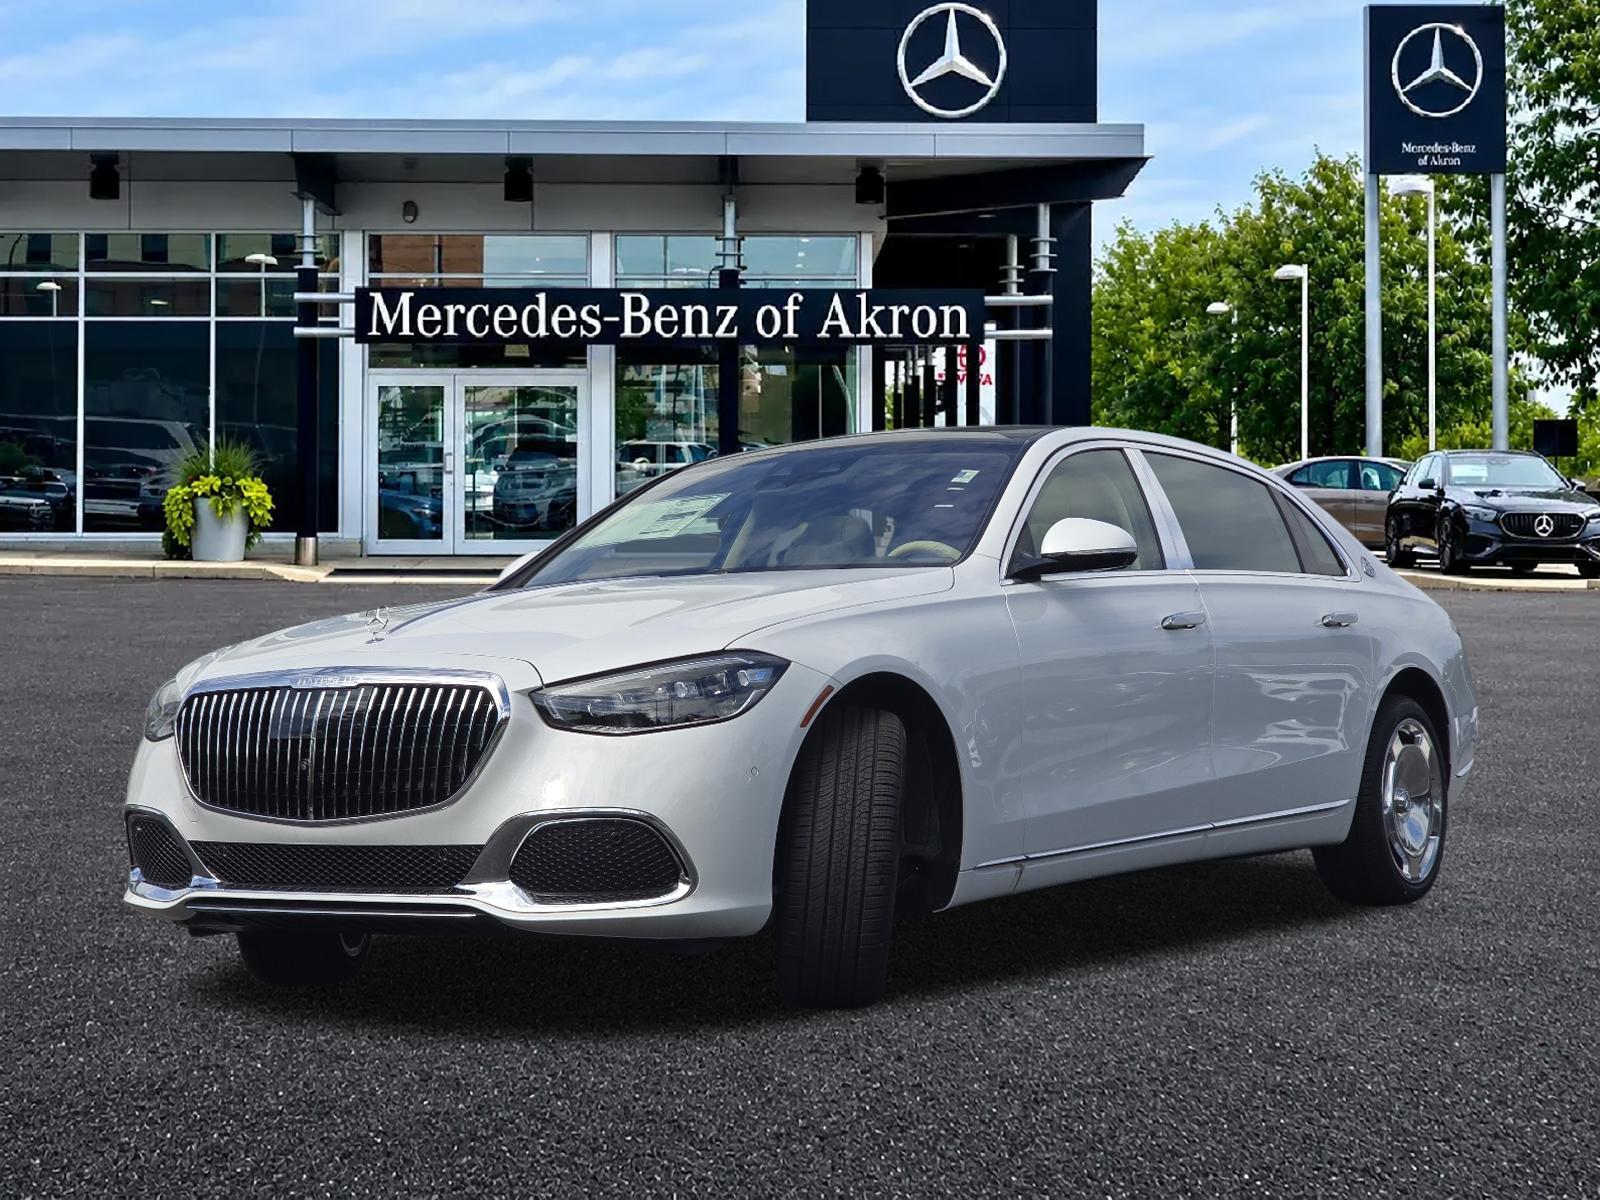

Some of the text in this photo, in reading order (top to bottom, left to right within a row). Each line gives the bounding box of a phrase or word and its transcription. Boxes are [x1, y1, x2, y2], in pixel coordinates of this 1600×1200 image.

[1401, 142, 1477, 154] Mercedes-Benz
[1417, 154, 1461, 166] of Akron
[367, 291, 971, 339] Mercedes-Benz of Akron
